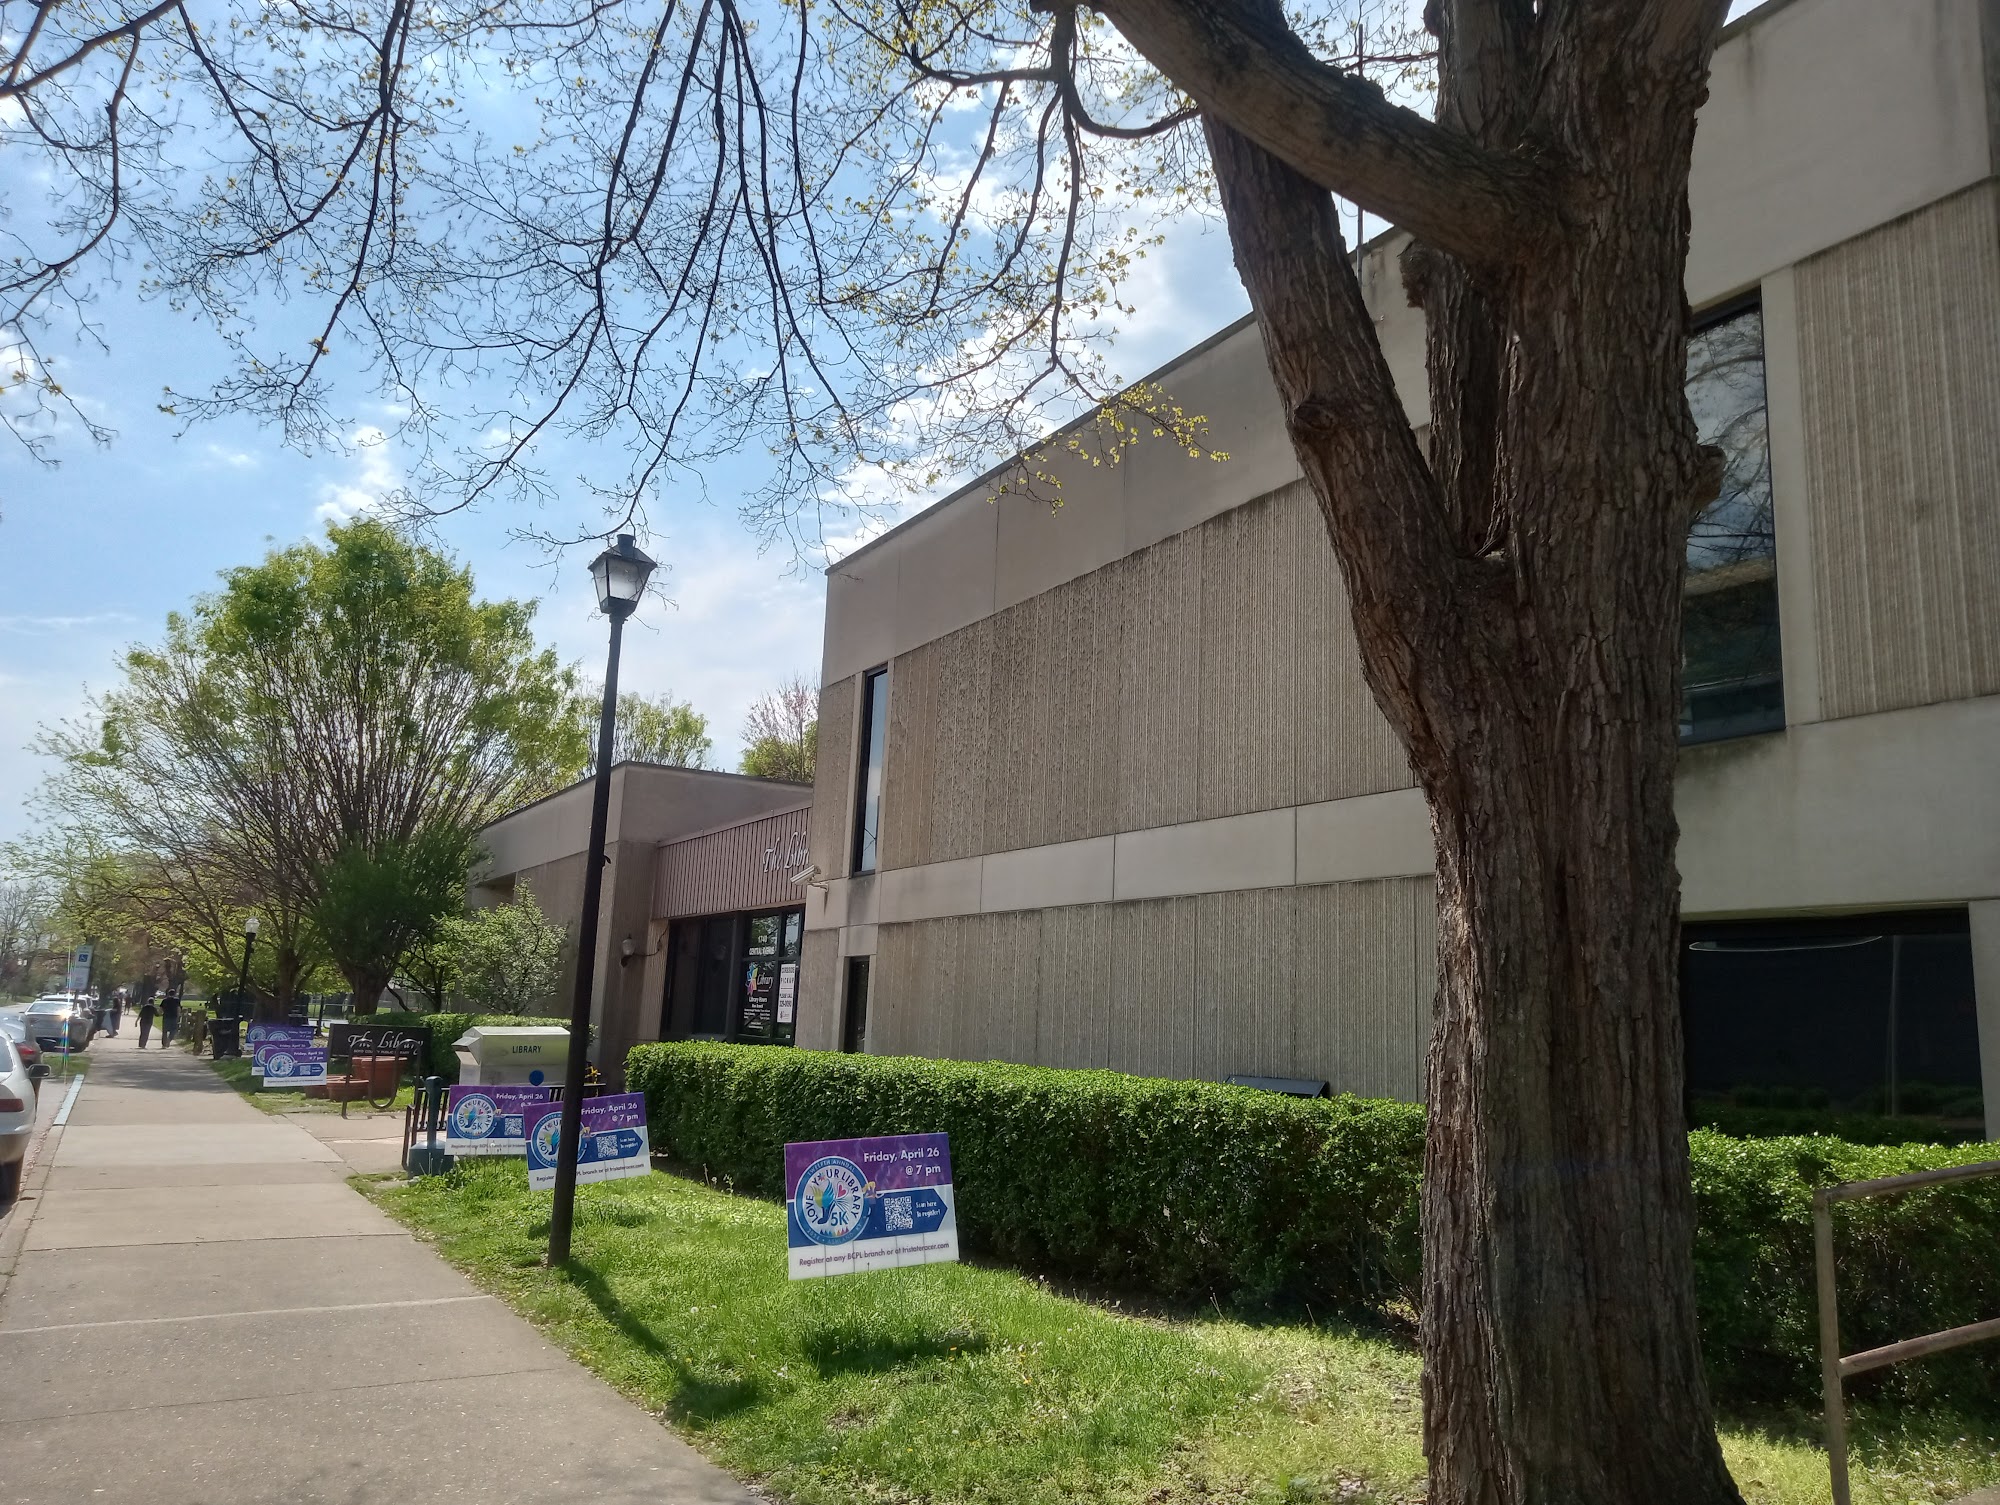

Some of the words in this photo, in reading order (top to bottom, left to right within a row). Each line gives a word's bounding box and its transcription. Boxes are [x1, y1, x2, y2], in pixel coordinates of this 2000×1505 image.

[763, 836, 782, 872] The
[512, 1045, 542, 1054] LIBRARY
[581, 1107, 606, 1115] Friday,
[608, 1105, 626, 1113] April
[626, 1114, 638, 1122] pm
[864, 1151, 897, 1163] Friday,
[901, 1148, 924, 1161] April
[927, 1147, 940, 1158] 26
[905, 1165, 913, 1175] @
[916, 1165, 922, 1174] 7
[925, 1165, 941, 1176] pm
[806, 1195, 818, 1223] LOVE
[842, 1172, 860, 1218] LIBRARY
[831, 1211, 848, 1226] 5K
[799, 1257, 824, 1267] Register
[834, 1255, 845, 1263] any
[864, 1248, 886, 1258] branch
